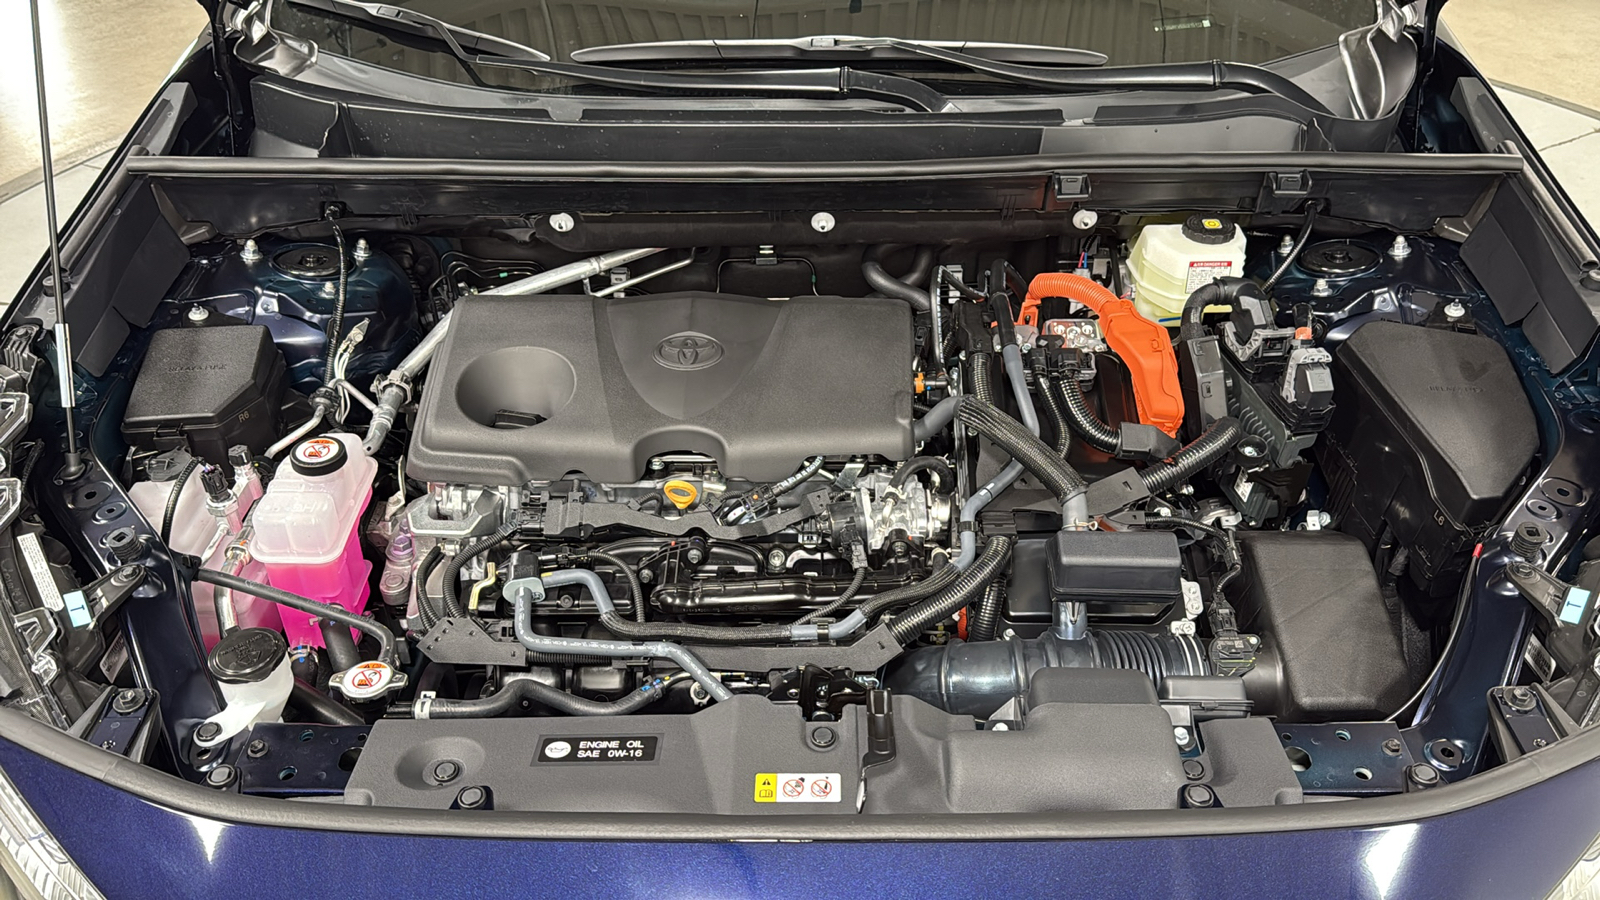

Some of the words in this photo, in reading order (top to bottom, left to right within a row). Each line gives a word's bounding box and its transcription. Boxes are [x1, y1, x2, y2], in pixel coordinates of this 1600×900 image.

[238, 410, 250, 423] R6
[1433, 509, 1445, 526] L6
[579, 740, 620, 749] ENGINE
[626, 740, 645, 749] OIL
[577, 750, 600, 758] SAE
[607, 749, 643, 758] 0W-16
